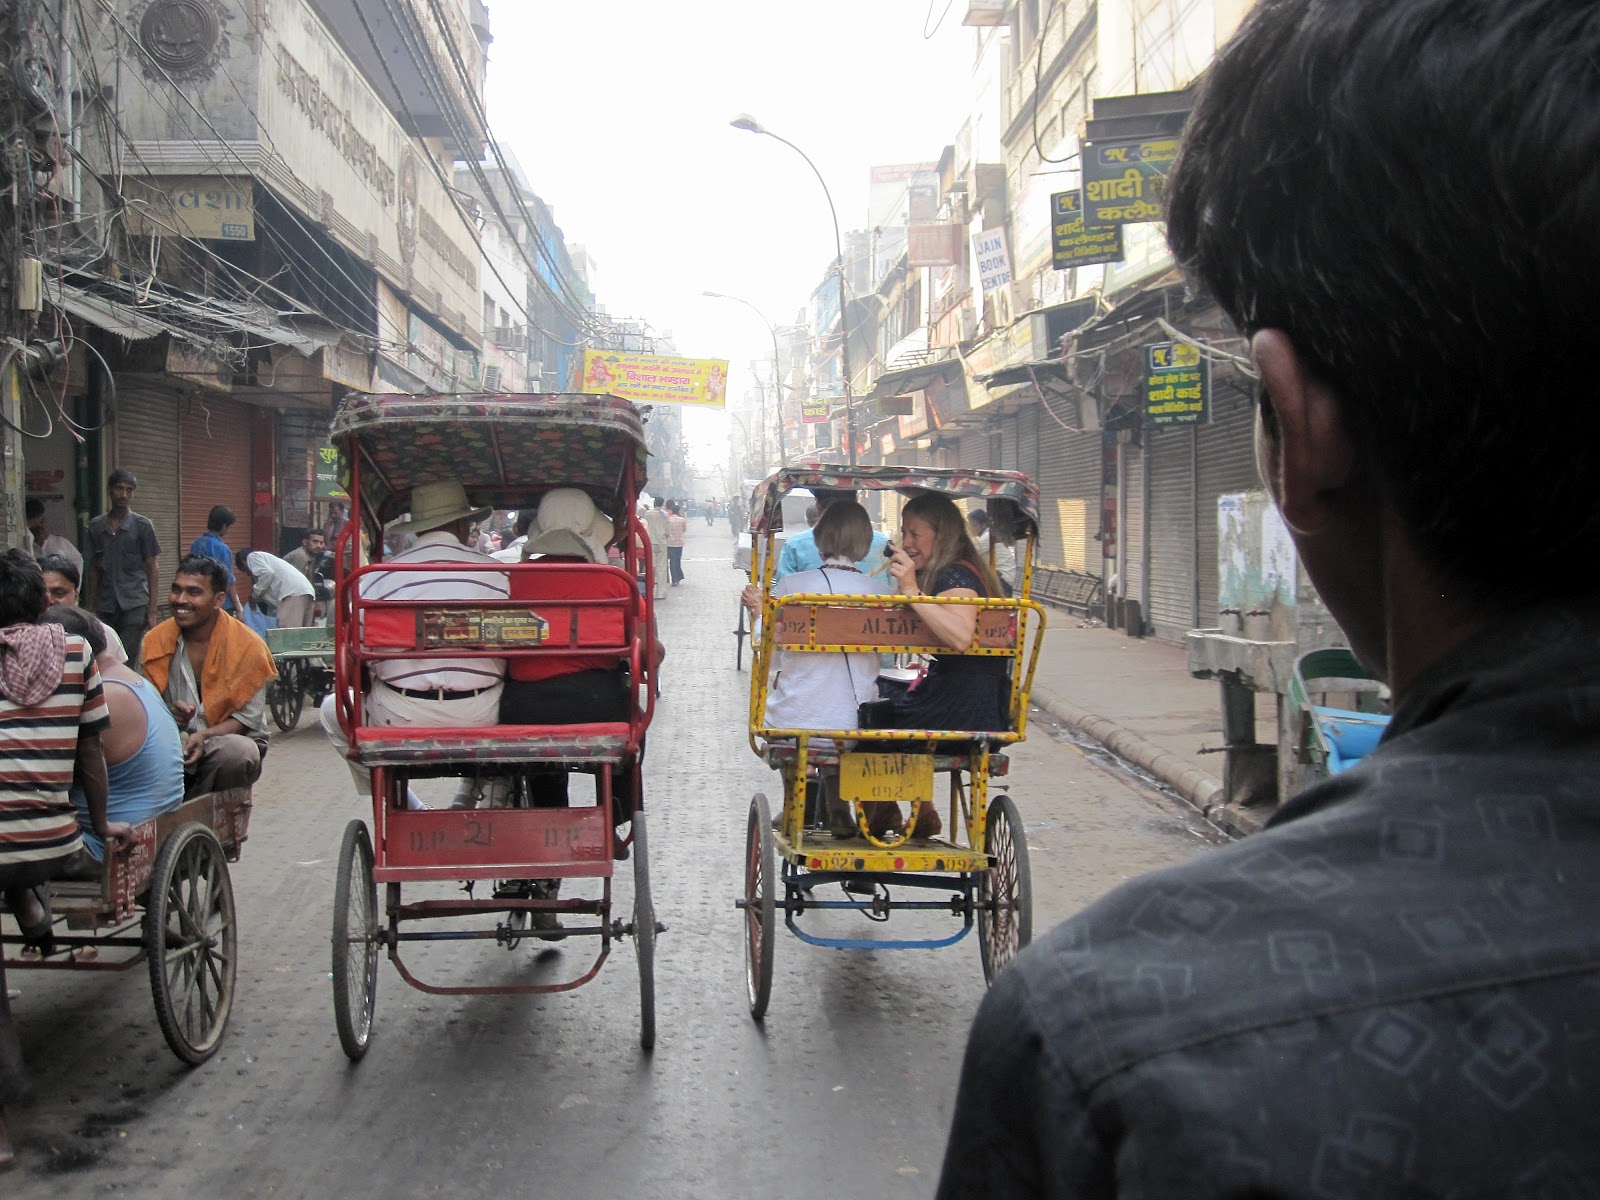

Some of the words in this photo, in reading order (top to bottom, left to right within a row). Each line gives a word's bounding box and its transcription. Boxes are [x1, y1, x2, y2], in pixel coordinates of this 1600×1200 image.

[1086, 168, 1143, 201] शादी
[224, 225, 246, 236] 1550
[978, 237, 1002, 255] JAIN
[980, 255, 1007, 273] BOOK
[982, 271, 1011, 291] CENTRE
[626, 371, 656, 383] विशाल
[1149, 385, 1174, 401] शादी
[1176, 382, 1202, 399] कार्ड
[862, 618, 922, 635] ALTAF
[862, 755, 908, 777] ALTAF
[872, 786, 904, 798] 092
[819, 857, 848, 869] 092
